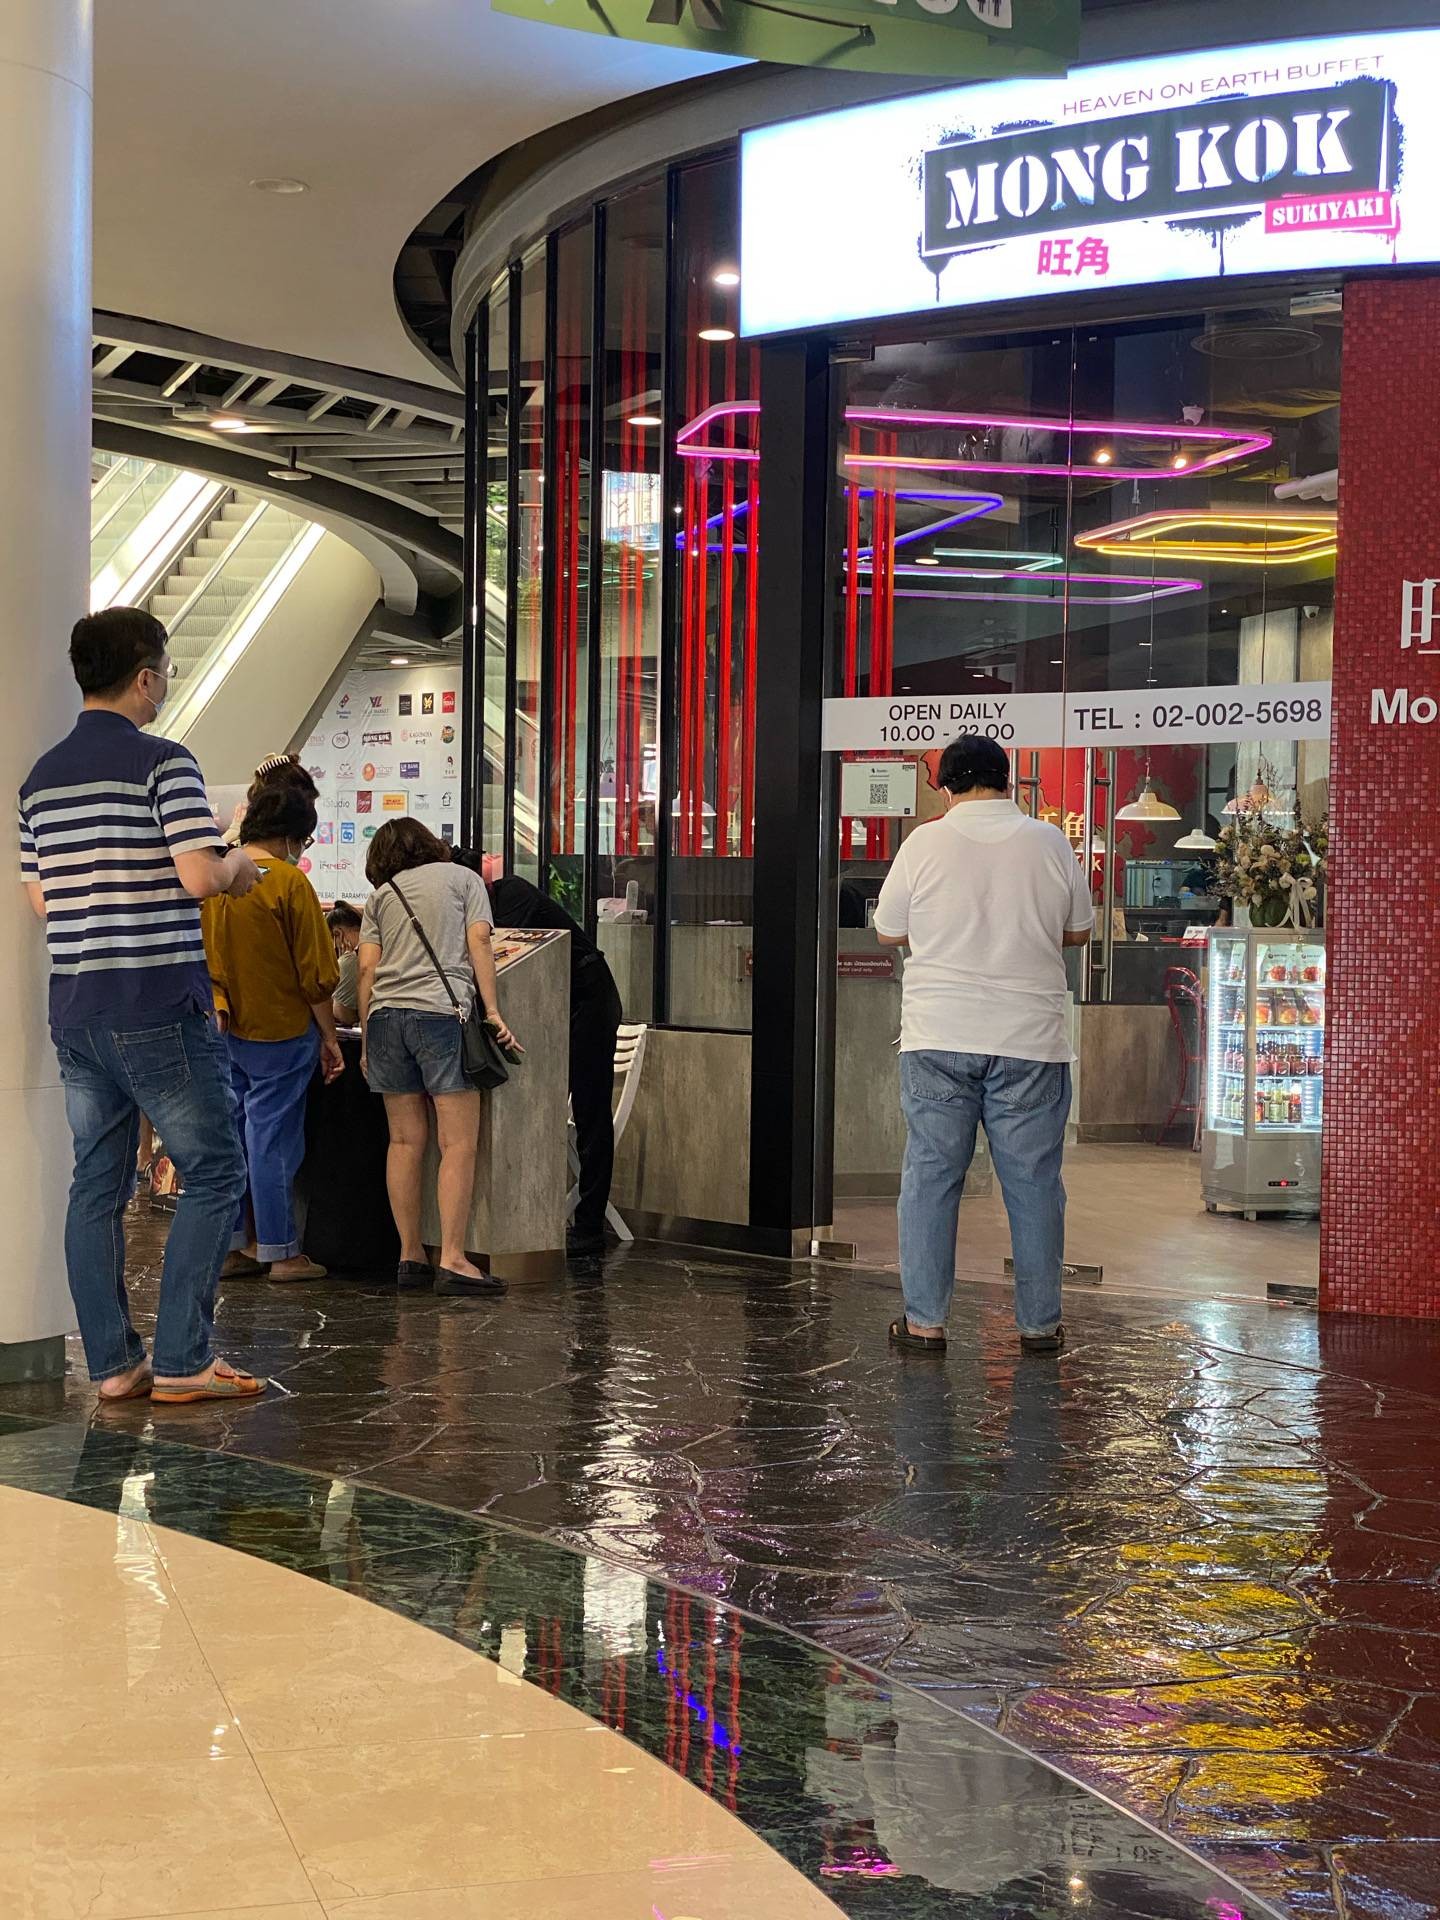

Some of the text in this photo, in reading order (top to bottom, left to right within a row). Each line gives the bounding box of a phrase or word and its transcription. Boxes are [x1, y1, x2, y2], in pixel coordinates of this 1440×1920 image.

[1063, 55, 1385, 115] HEAVEN ON EARTH BUFFET
[945, 108, 1353, 231] MONG KOK
[1271, 196, 1384, 227] SUKIYAKI
[1036, 238, 1110, 276] 旺角
[889, 702, 1007, 721] OPEN DAILY
[1074, 707, 1123, 730] TEL
[1152, 699, 1322, 728] 02-002-5698
